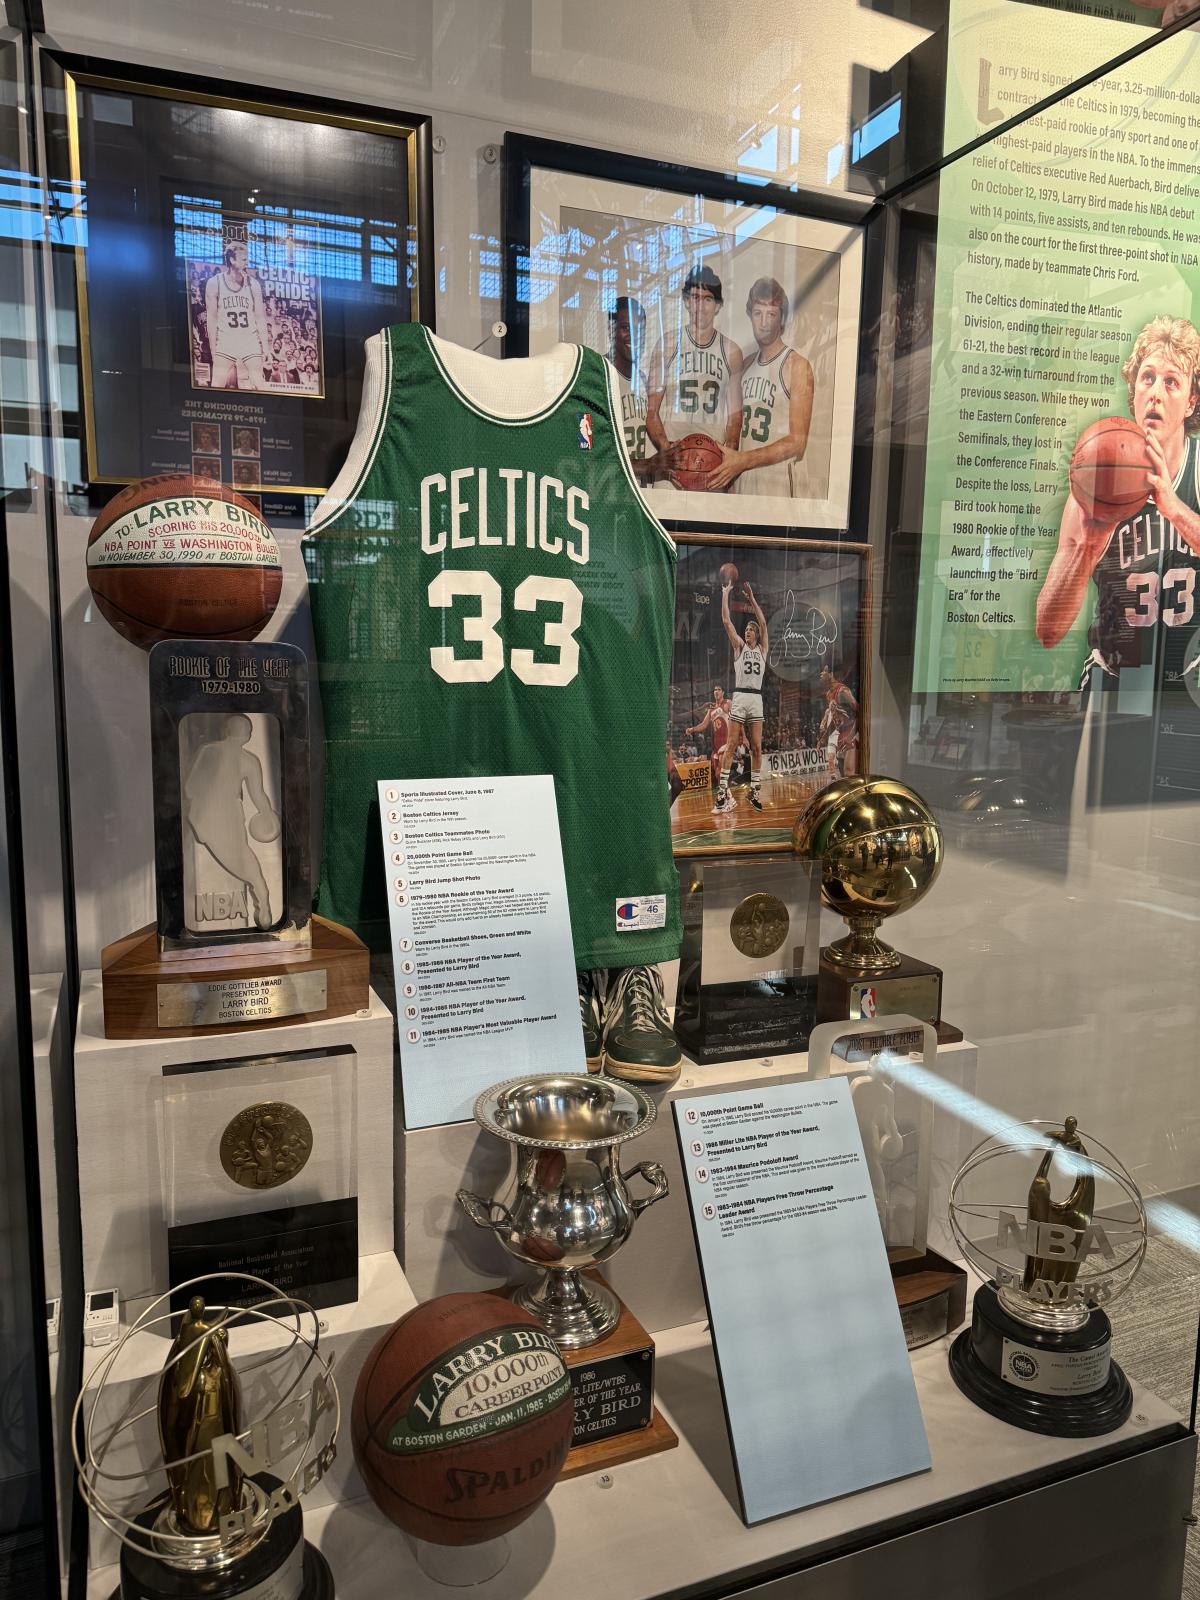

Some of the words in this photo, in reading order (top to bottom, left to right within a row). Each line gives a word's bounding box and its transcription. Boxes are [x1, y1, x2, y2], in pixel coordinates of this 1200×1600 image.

[972, 179, 983, 191] On
[987, 181, 1023, 197] October
[1026, 187, 1036, 200] 12,
[1039, 189, 1060, 203] 1979,
[1062, 192, 1086, 208] Larry
[1089, 195, 1106, 208] Bird
[1109, 200, 1133, 211] made
[1135, 201, 1147, 213] his
[1150, 203, 1168, 216] NBA
[1170, 206, 1194, 219] debut
[968, 251, 1002, 269] history,
[1005, 258, 1030, 269] made
[1033, 259, 1043, 274] by
[1046, 261, 1090, 276] teammate
[1093, 266, 1115, 279] Chris
[1118, 269, 1139, 282] Ford.
[265, 281, 310, 300] PRIDE
[222, 296, 249, 309] CELTICS
[966, 291, 982, 304] The
[985, 294, 1017, 307] Celtics
[1020, 297, 1069, 312] dominated
[1072, 302, 1085, 314] the
[1088, 304, 1122, 318] Atlantic
[227, 312, 248, 328] 33
[679, 380, 720, 414] 53
[961, 387, 1001, 399] previous
[1004, 391, 1039, 402] season.
[1042, 392, 1066, 404] While
[1069, 393, 1088, 408] they
[1091, 397, 1110, 407] won
[741, 405, 772, 442] 33
[115, 524, 133, 539] TO:
[134, 500, 213, 528] LARRY
[226, 505, 270, 539] BIRD
[421, 467, 589, 565] CELTICS
[148, 520, 196, 538] SCORING
[953, 524, 973, 534] 1980
[977, 524, 1007, 535] Rookie
[1010, 525, 1019, 536] of
[1021, 525, 1035, 536] the
[1038, 526, 1057, 537] Year
[105, 542, 123, 552] NBA
[128, 540, 158, 550] POINT
[180, 539, 252, 551] WASHINGTON
[1118, 510, 1196, 569] CELTIC
[107, 551, 156, 560] NOVEMBER
[220, 552, 253, 560] BOSTON
[951, 545, 983, 558] Award,
[985, 546, 1033, 559] effectively
[950, 569, 996, 581] launching
[998, 569, 1013, 579] the
[970, 590, 983, 601] for
[986, 590, 1000, 601] the
[1125, 567, 1196, 626] 33
[948, 612, 979, 623] Boston
[982, 612, 1015, 623] Celtics.
[428, 570, 583, 686] 33
[169, 656, 210, 677] ROOKIE
[216, 657, 230, 678] OF
[239, 658, 257, 678] THE
[263, 659, 289, 678] YEAR
[744, 662, 761, 675] 33
[202, 681, 260, 694] 1979-1980
[769, 755, 779, 770] 16
[781, 752, 801, 768] NBA
[802, 749, 828, 764] WORL
[195, 891, 249, 922] NBA
[647, 905, 658, 913] 46
[222, 990, 259, 998] PRESENTED
[229, 982, 259, 990] GOTTLIEB
[223, 999, 248, 1008] LARRY
[251, 997, 268, 1006] BIRD
[246, 1007, 272, 1015] CELTICS
[688, 1112, 695, 1120] 12
[705, 1207, 712, 1215] 15
[998, 1211, 1115, 1262] NBA
[414, 1336, 504, 1423] LARRY
[583, 1375, 626, 1393] LITE/WTBS
[455, 1381, 534, 1418] CAREER
[533, 1366, 562, 1389] POINT
[588, 1394, 598, 1404] OF
[601, 1390, 616, 1400] THE
[619, 1383, 640, 1395] YEAR
[601, 1396, 640, 1415] BIRD
[393, 1437, 404, 1446] AT
[405, 1434, 443, 1446] BOSTON
[445, 1422, 487, 1440] GARDEN
[495, 1412, 516, 1426] JAN.
[588, 1417, 616, 1431] CELTICS
[601, 1475, 610, 1483] 13
